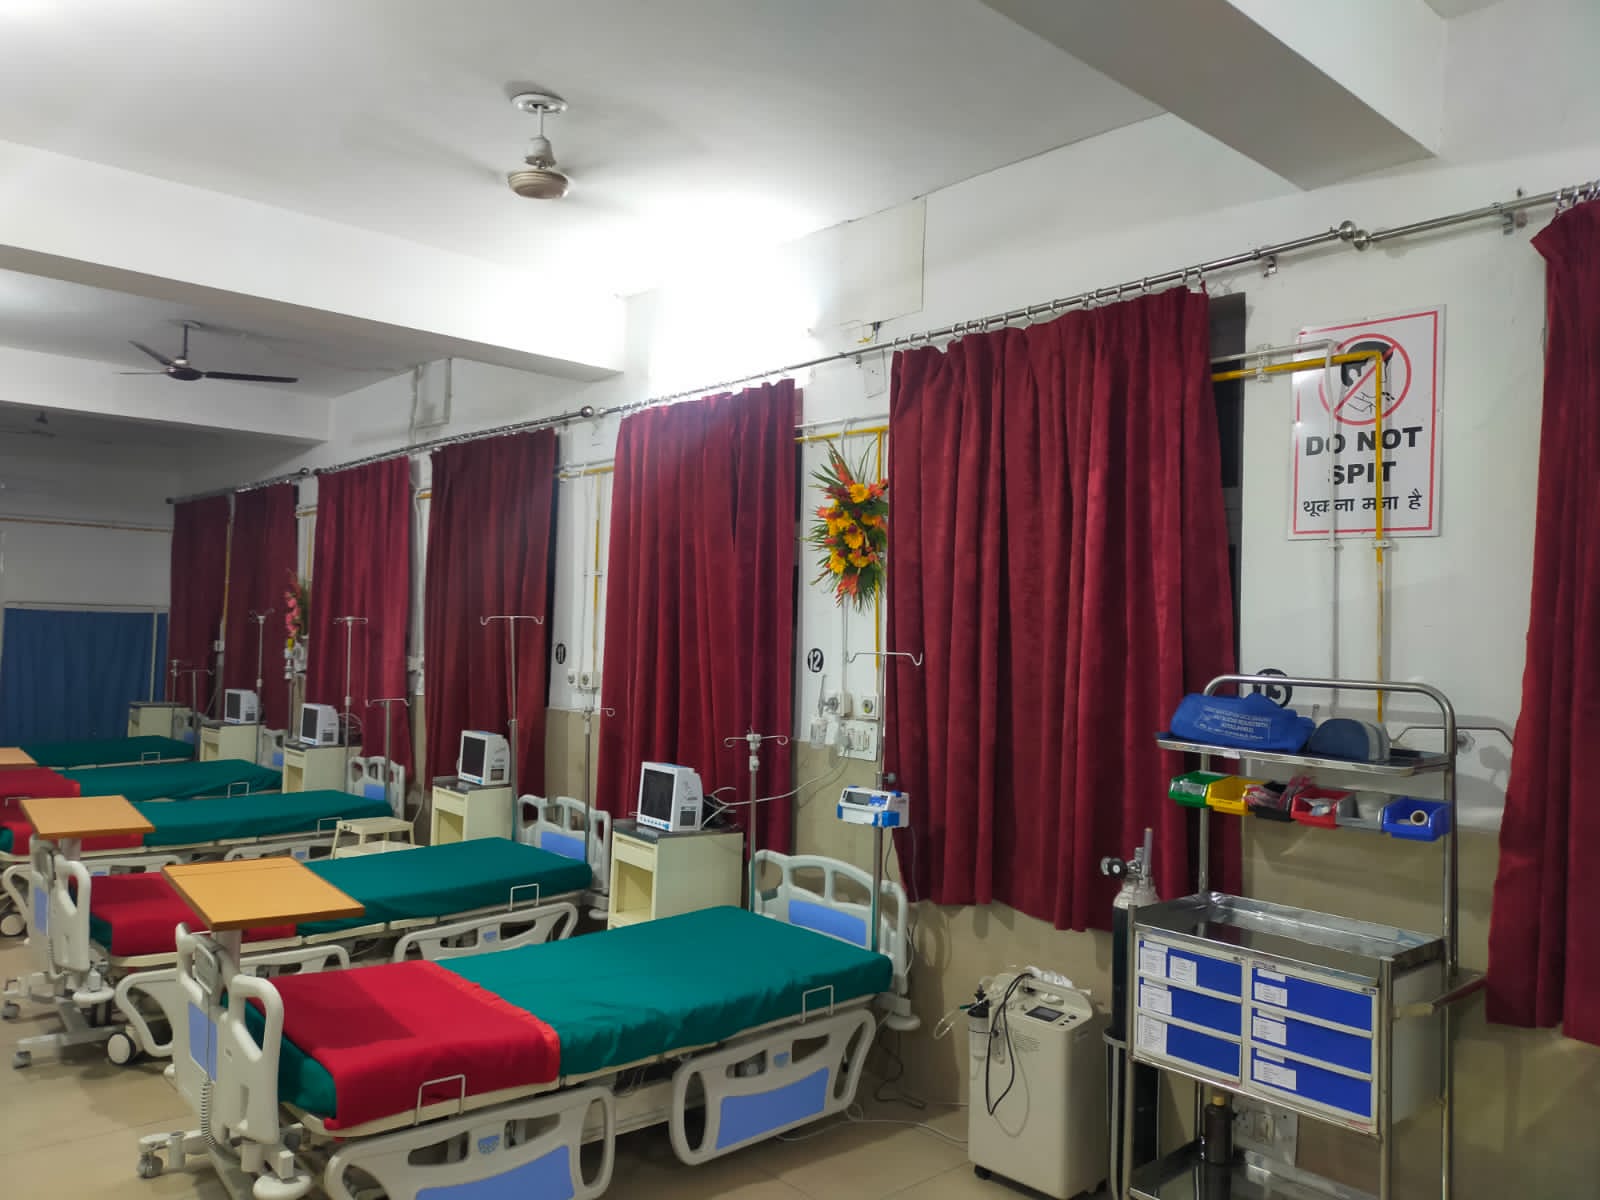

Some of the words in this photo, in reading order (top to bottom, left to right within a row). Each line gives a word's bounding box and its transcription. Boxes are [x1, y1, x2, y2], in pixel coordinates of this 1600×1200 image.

[1306, 433, 1346, 456] DO
[1357, 426, 1423, 452] NOT
[1328, 461, 1397, 485] SPIT
[1408, 488, 1422, 510] है
